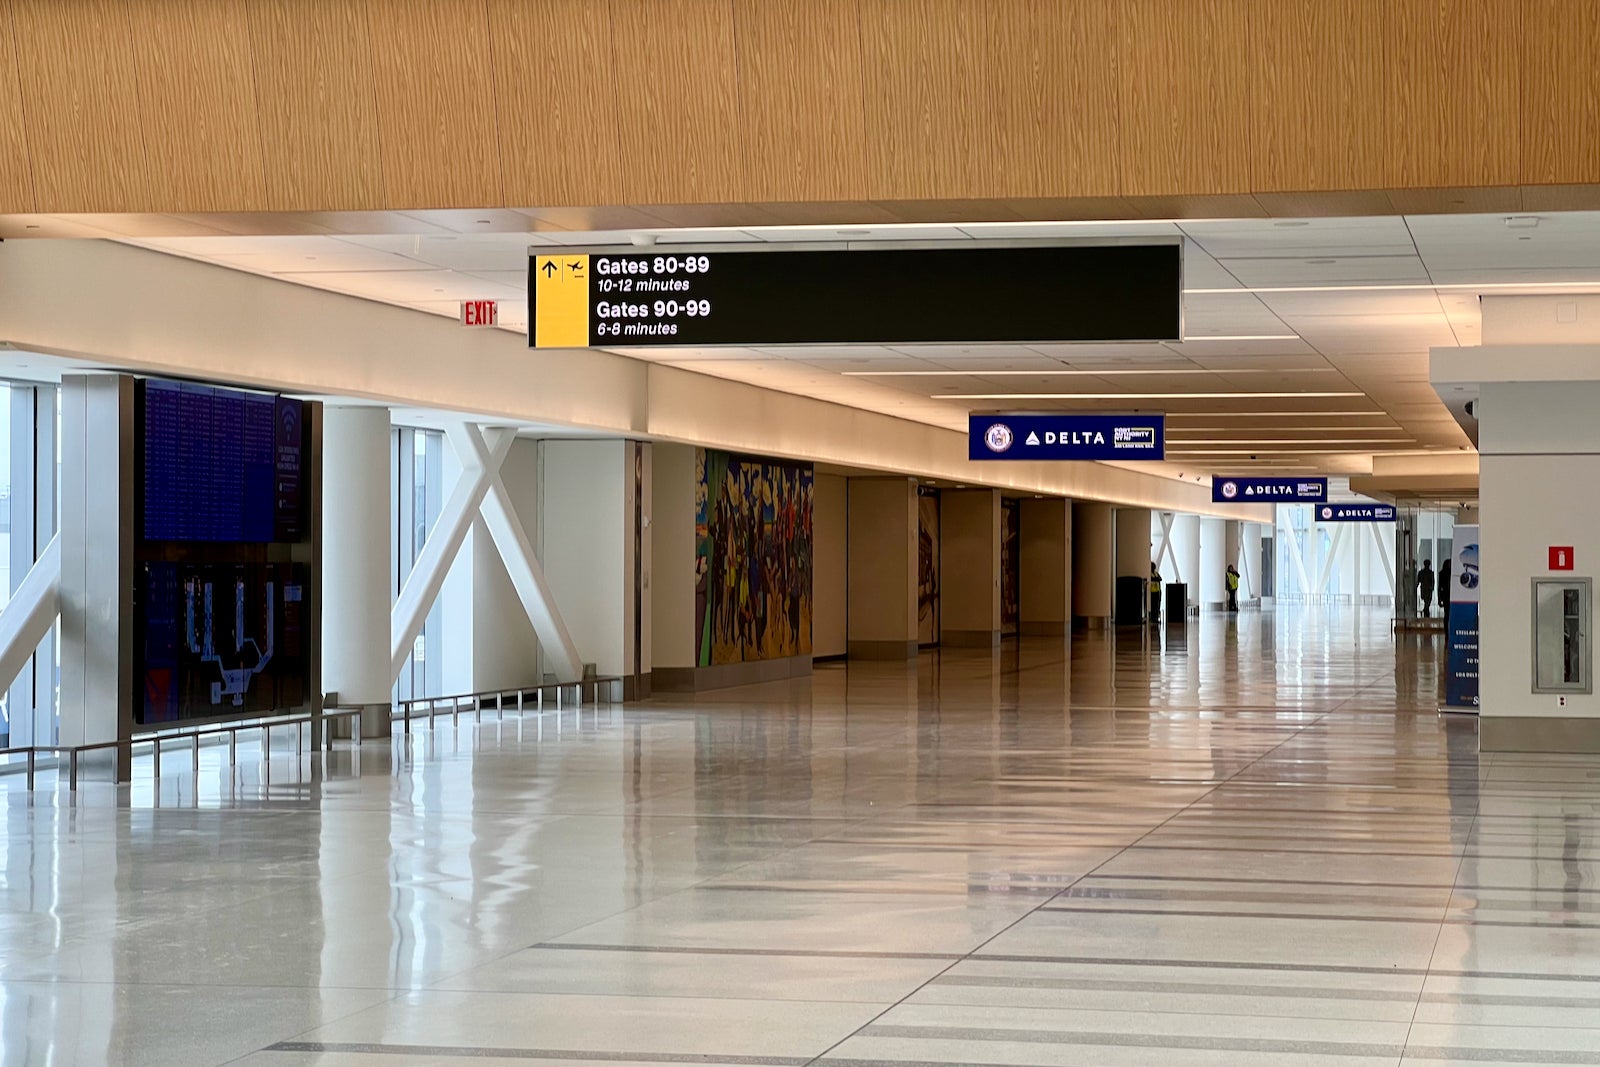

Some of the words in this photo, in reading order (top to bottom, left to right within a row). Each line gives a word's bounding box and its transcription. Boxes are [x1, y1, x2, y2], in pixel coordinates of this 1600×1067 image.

[597, 257, 649, 276] Gates
[653, 255, 710, 274] 80-89
[597, 278, 632, 292] 10-12
[636, 278, 690, 292] minutes
[465, 301, 494, 326] EXIT
[597, 300, 649, 319] Gates
[653, 299, 711, 318] 90-99
[597, 322, 621, 336] 6-8
[625, 322, 678, 336] minutes
[1045, 432, 1105, 444] DELTA
[1256, 486, 1293, 495] DELTA
[1345, 509, 1372, 517] DELTA
